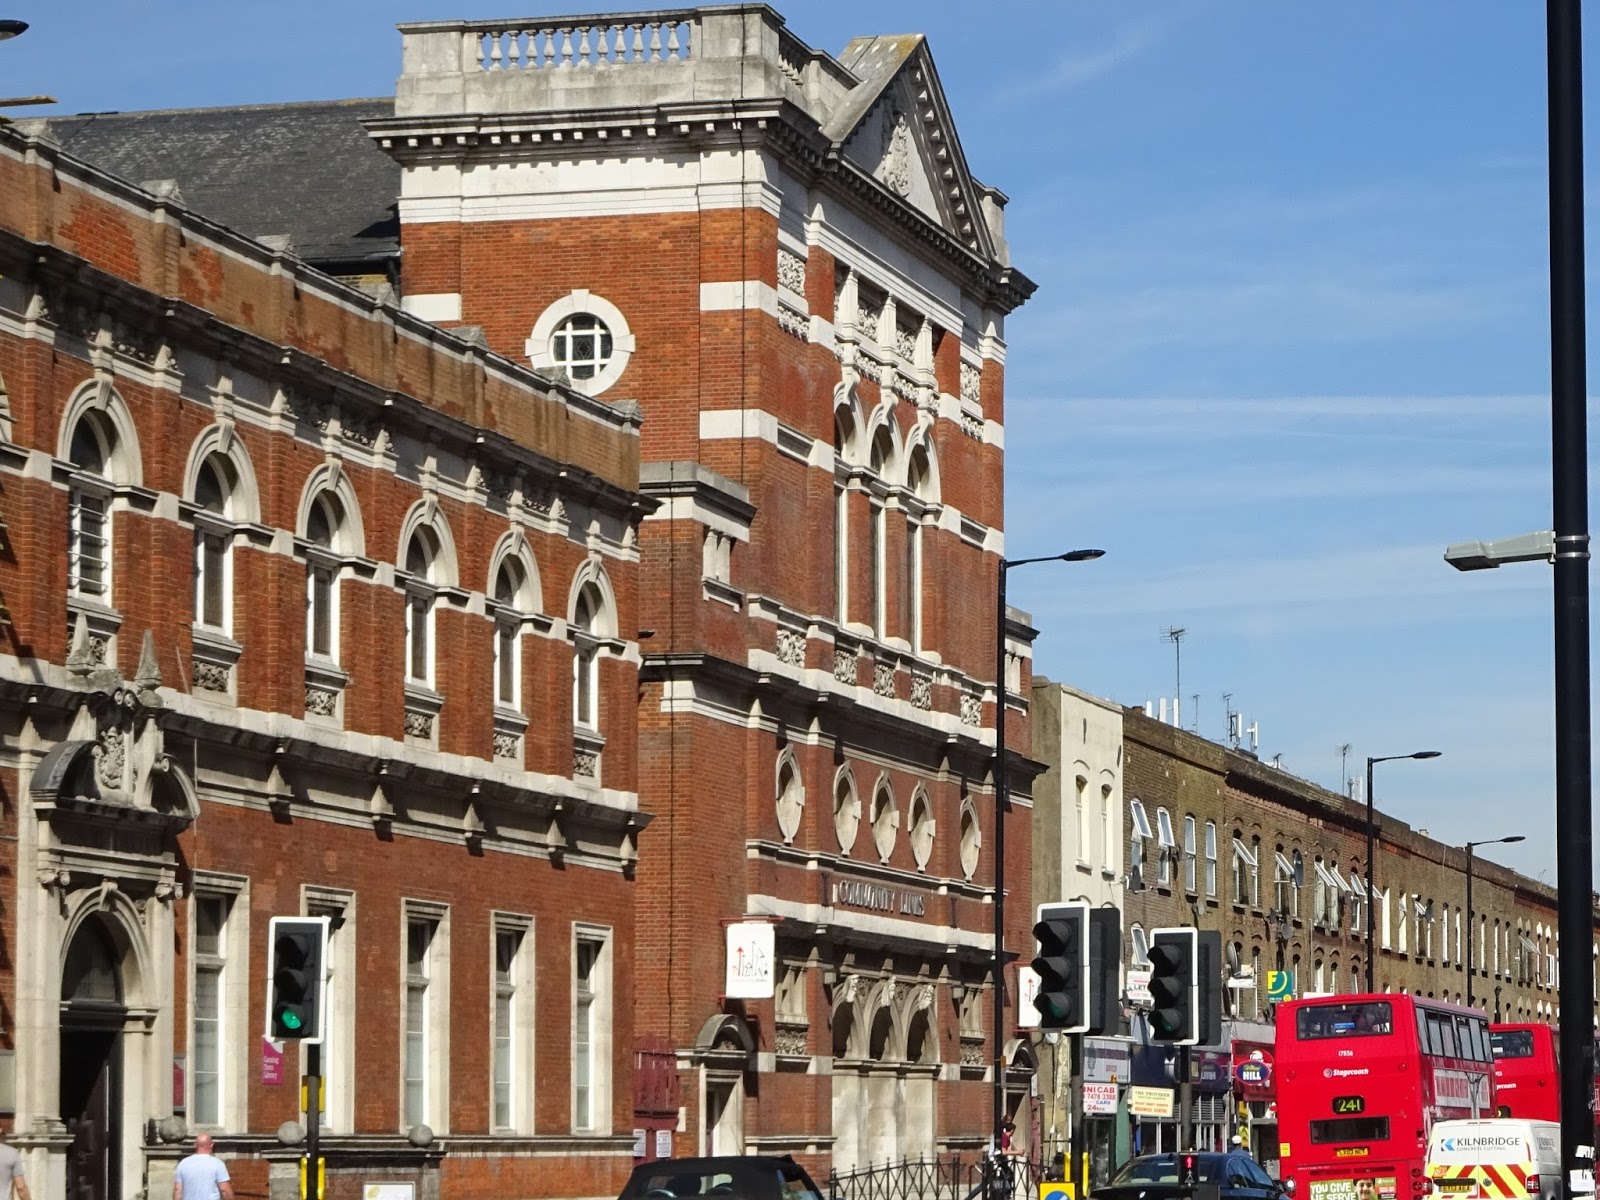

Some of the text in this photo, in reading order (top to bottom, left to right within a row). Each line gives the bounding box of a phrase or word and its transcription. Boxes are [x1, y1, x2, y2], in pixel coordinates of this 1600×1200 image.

[1242, 1071, 1262, 1080] HILL
[1333, 1068, 1369, 1077] Stagecoach
[1339, 1099, 1361, 1112] 241
[1457, 1137, 1520, 1146] KILNBRIDGE
[1310, 1182, 1352, 1194] YOU GIVE
